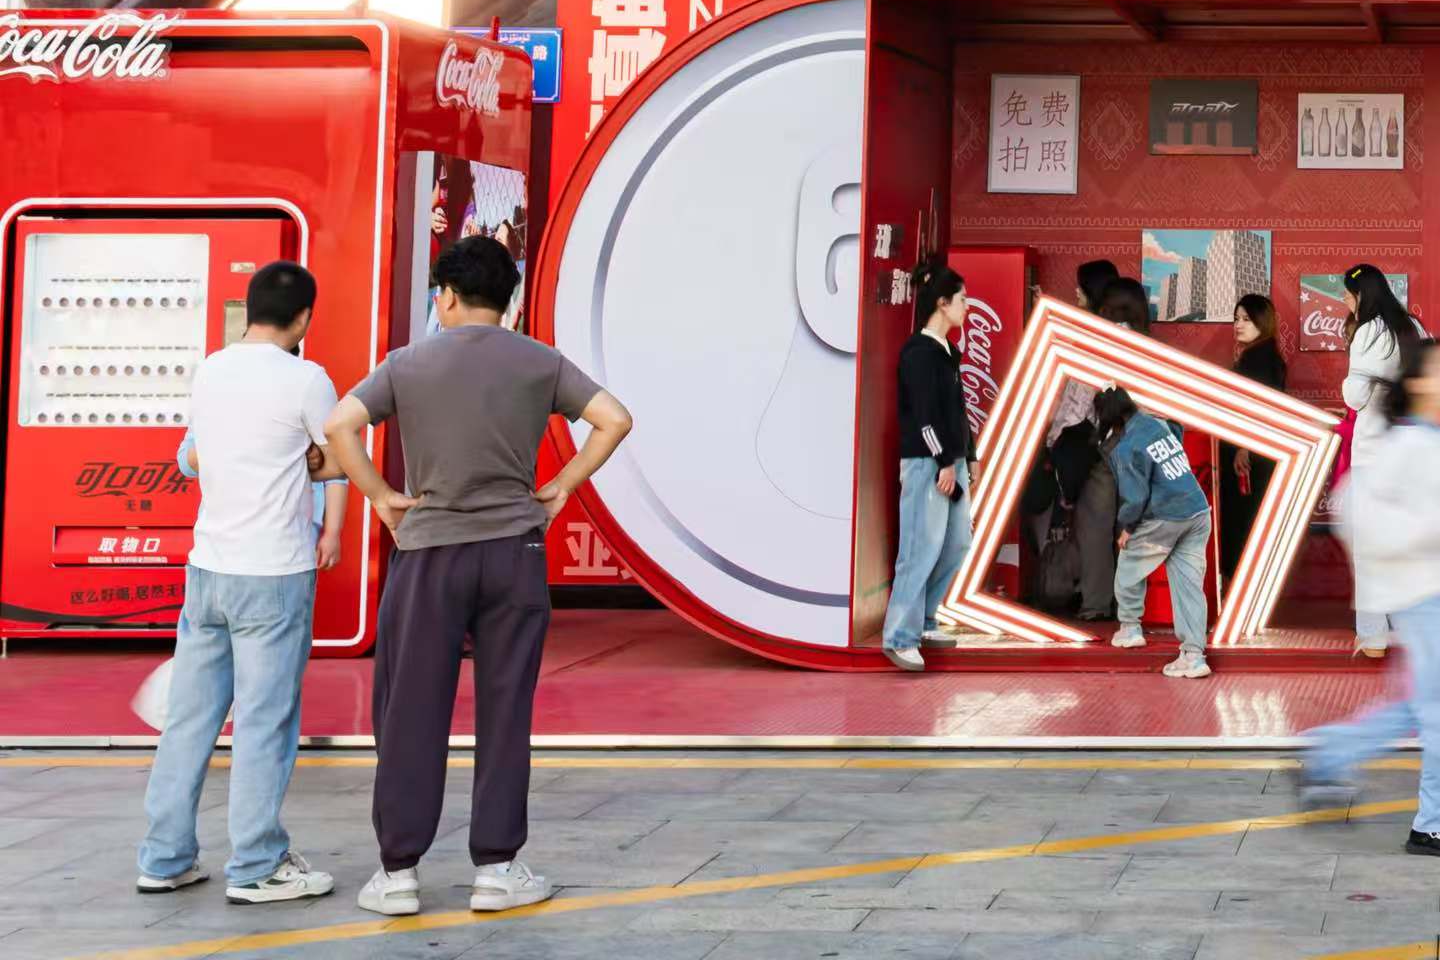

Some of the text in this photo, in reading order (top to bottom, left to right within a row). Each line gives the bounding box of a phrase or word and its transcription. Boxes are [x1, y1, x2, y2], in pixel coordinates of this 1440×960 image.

[437, 40, 503, 113] Coca-Cola
[1000, 89, 1069, 128] 免费
[998, 136, 1067, 172] 拍照
[98, 537, 160, 553] 取物口
